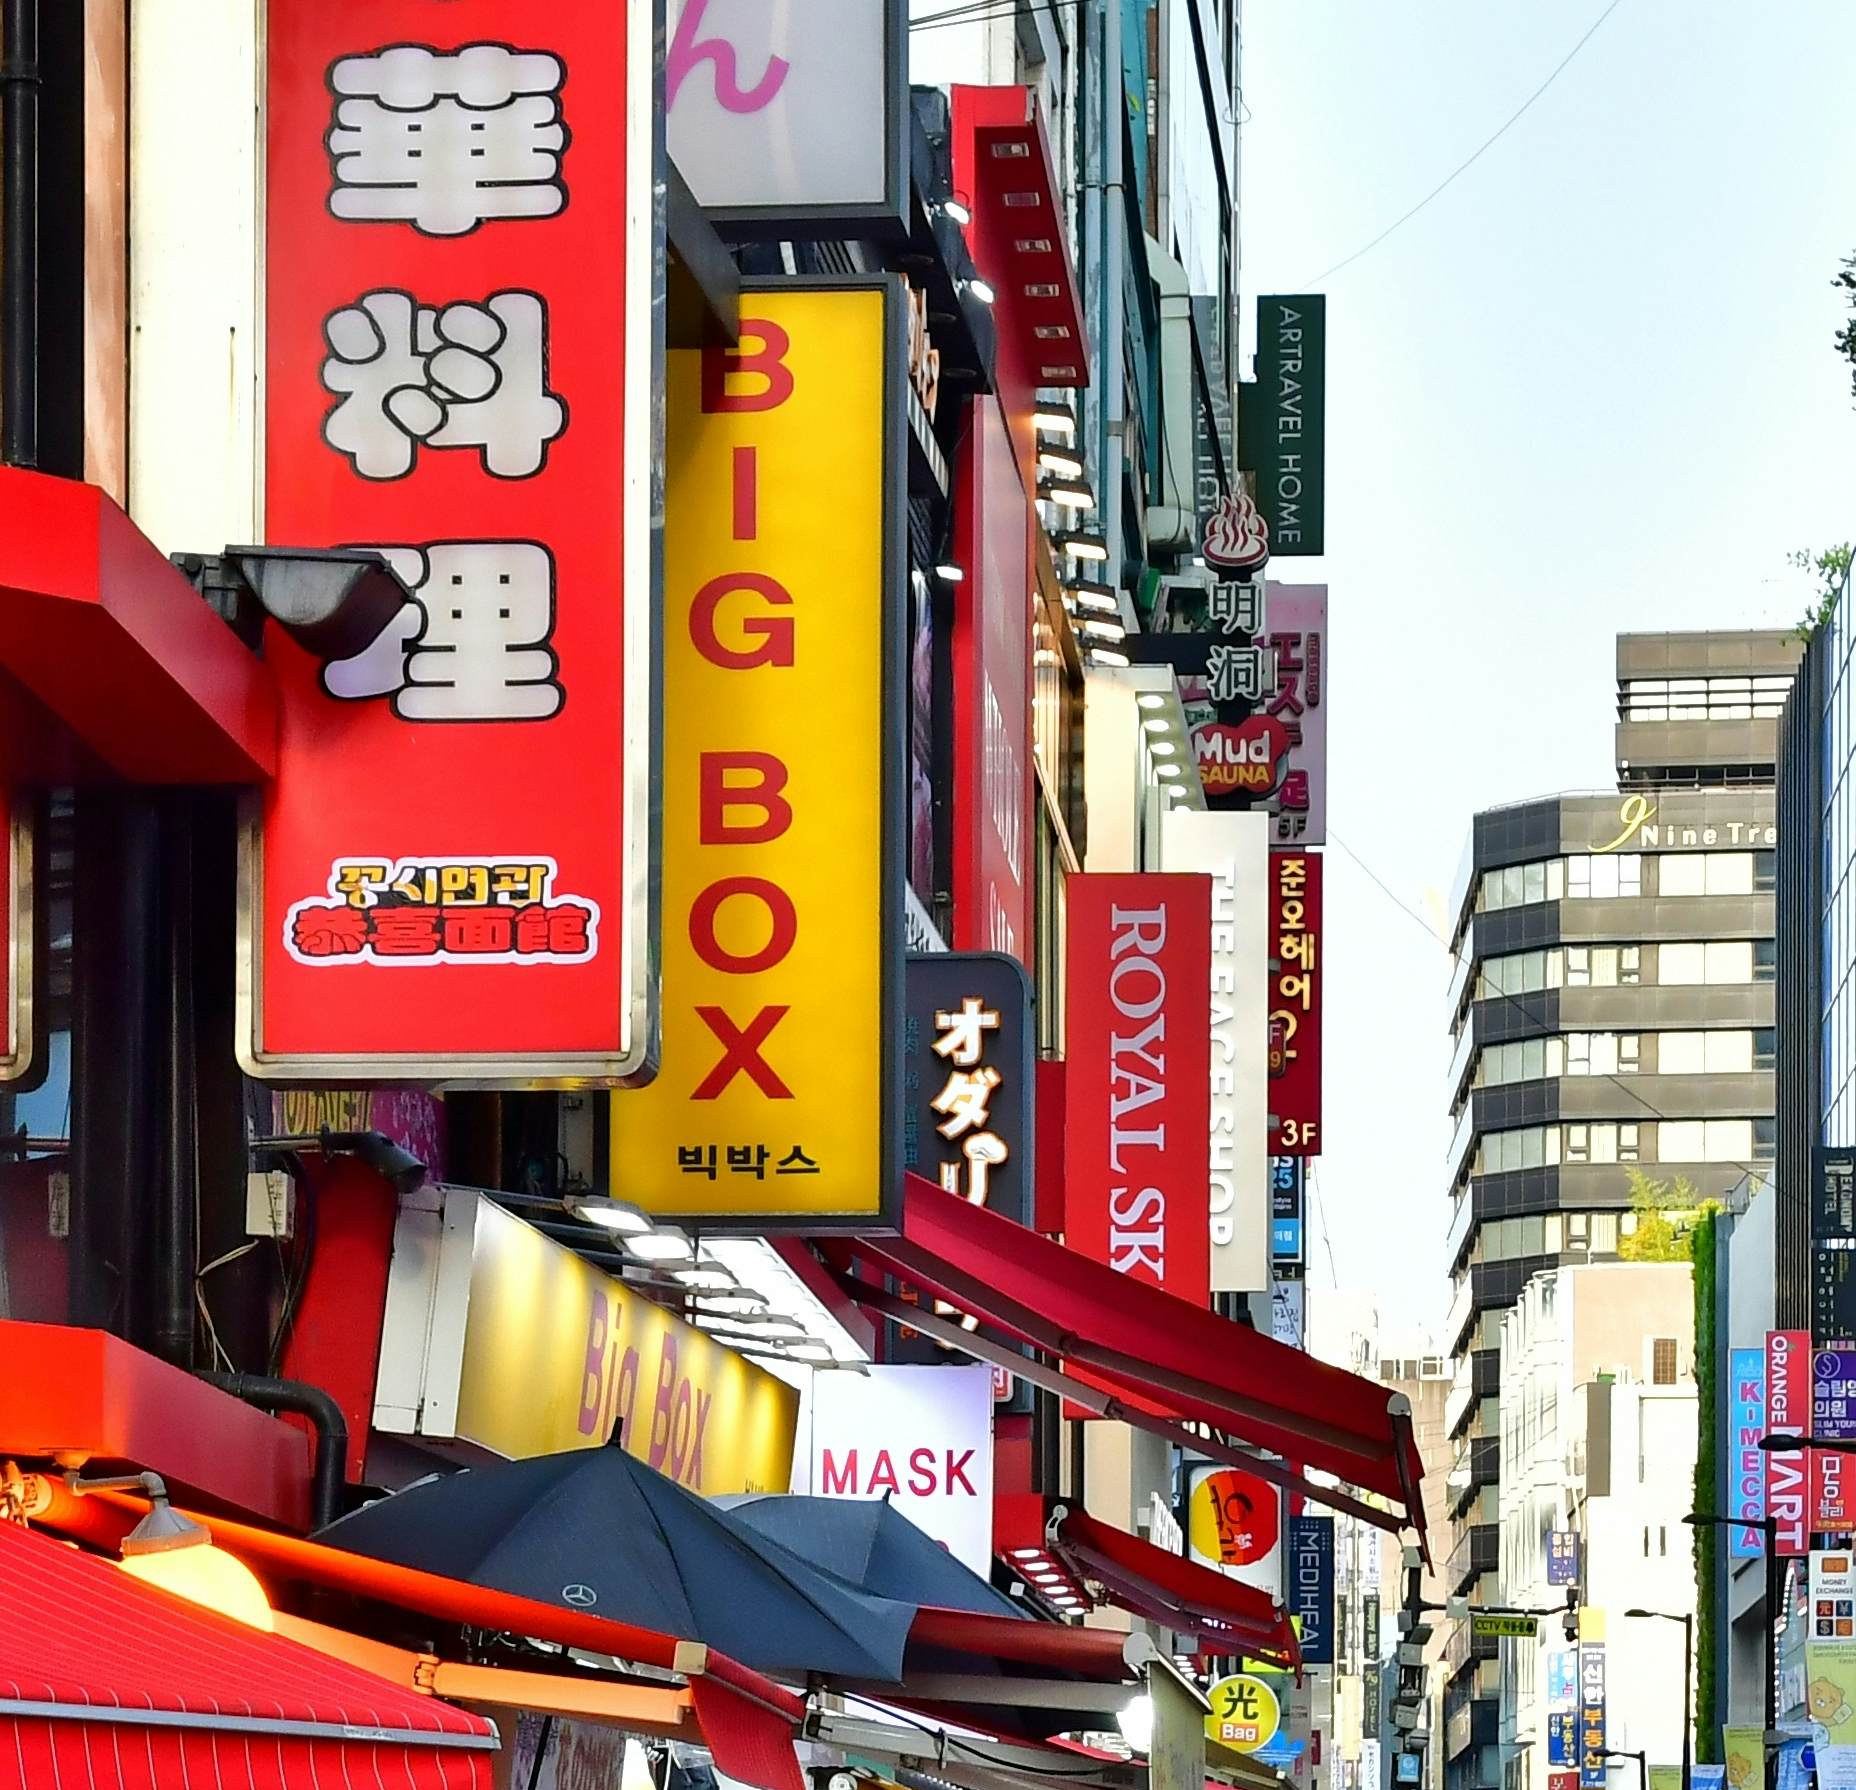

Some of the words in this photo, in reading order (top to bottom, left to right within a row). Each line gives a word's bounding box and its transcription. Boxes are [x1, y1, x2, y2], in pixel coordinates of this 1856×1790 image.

[322, 42, 572, 722] 華料理
[1278, 305, 1303, 445] ARTRAVEL
[688, 318, 797, 672] BIG
[1278, 454, 1303, 545] HOME
[1206, 580, 1263, 702] 明洞
[1195, 730, 1270, 764] Mud
[1198, 764, 1270, 784] SAUNA
[1640, 823, 1718, 848] Nine
[1727, 820, 1776, 845] Tre
[337, 864, 549, 910] 꽁시면관
[292, 905, 593, 956] 恭喜面館
[688, 751, 798, 1101] BOX
[1279, 859, 1315, 1011] 준오헤어
[1110, 902, 1168, 1175] ROYAL
[678, 1143, 822, 1182] 빅박스
[1281, 1119, 1316, 1147] 3F
[1110, 1185, 1168, 1289] SK
[1771, 1335, 1787, 1424] ORANGE
[1814, 1399, 1847, 1419] 의원
[822, 1446, 979, 1498] MASK
[1740, 1381, 1763, 1549] KIMECCA
[1770, 1425, 1804, 1551] MART
[1474, 1618, 1502, 1631] CCTV
[1222, 1683, 1260, 1721] 光
[1222, 1724, 1257, 1741] Bag
